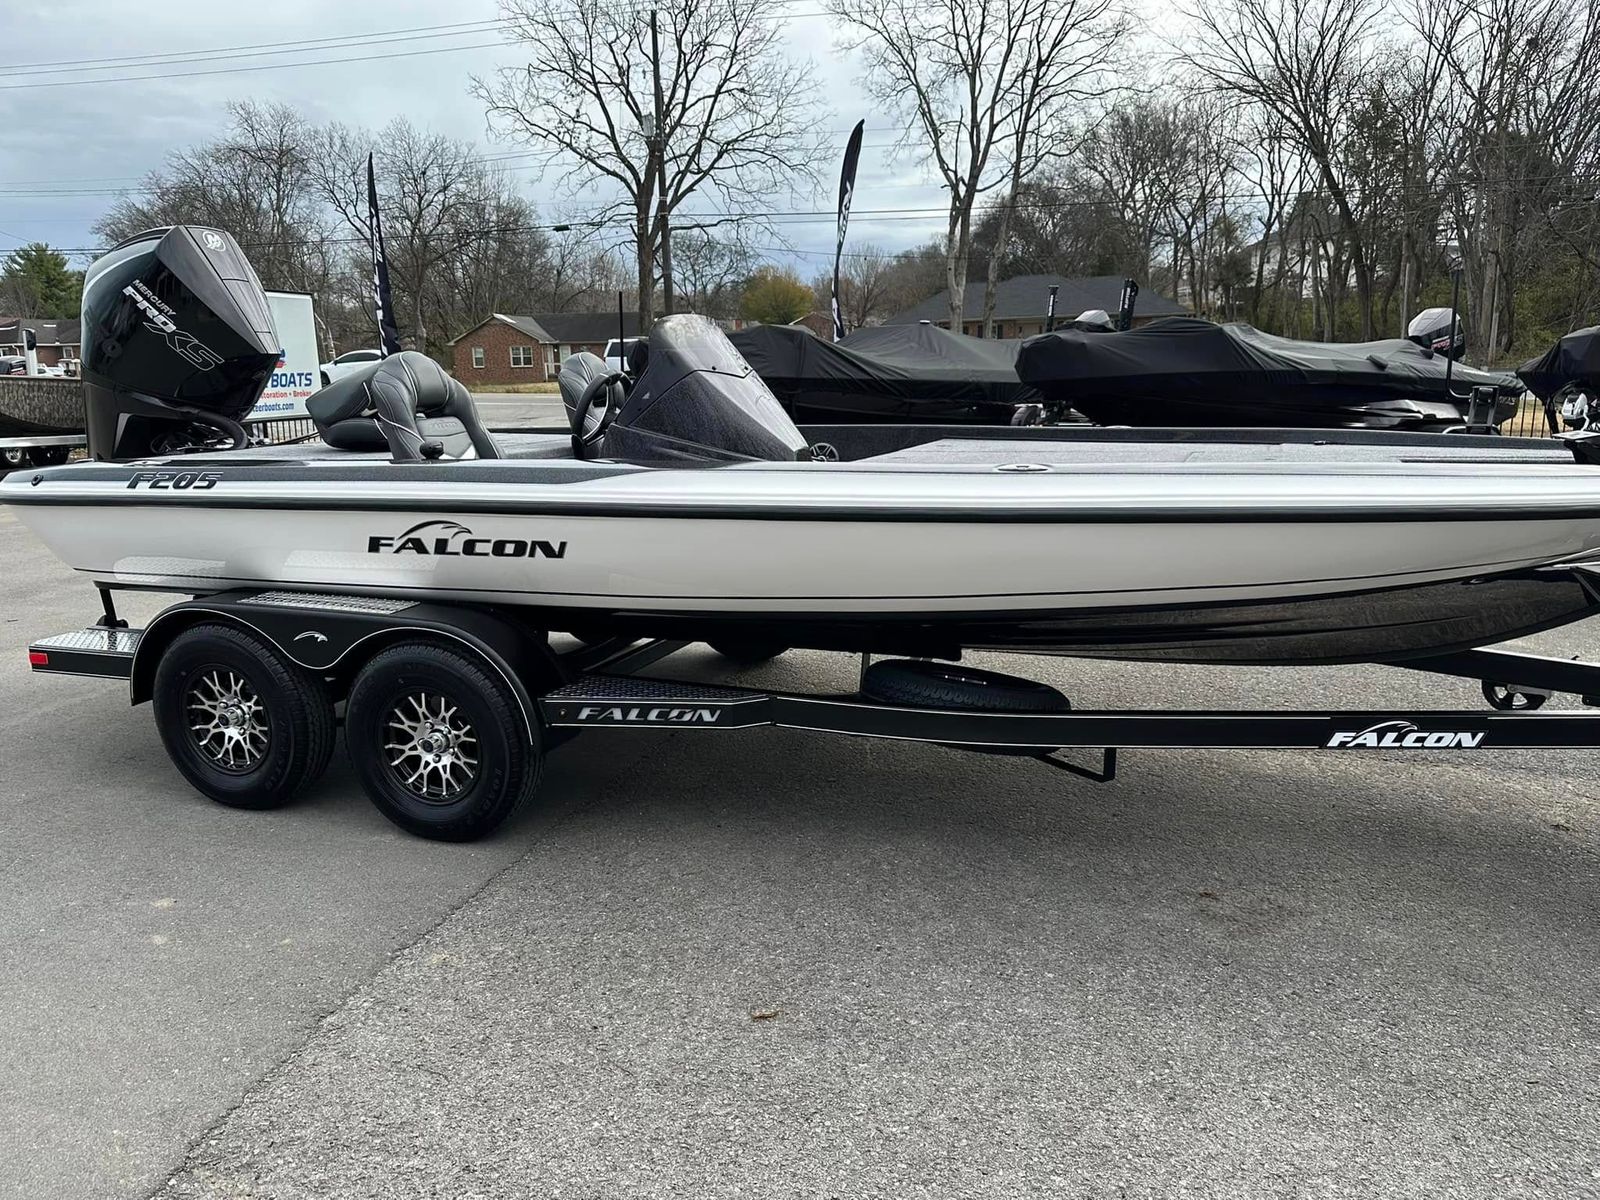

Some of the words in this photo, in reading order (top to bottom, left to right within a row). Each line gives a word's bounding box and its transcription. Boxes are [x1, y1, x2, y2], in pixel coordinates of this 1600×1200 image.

[132, 279, 177, 316] MERCURY
[122, 285, 177, 333] PRO
[142, 321, 225, 371] XS
[270, 372, 313, 388] BOATS
[126, 472, 224, 489] F205
[367, 535, 568, 559] FALCON
[577, 706, 722, 723] FALCON
[1326, 731, 1486, 748] FALCON
